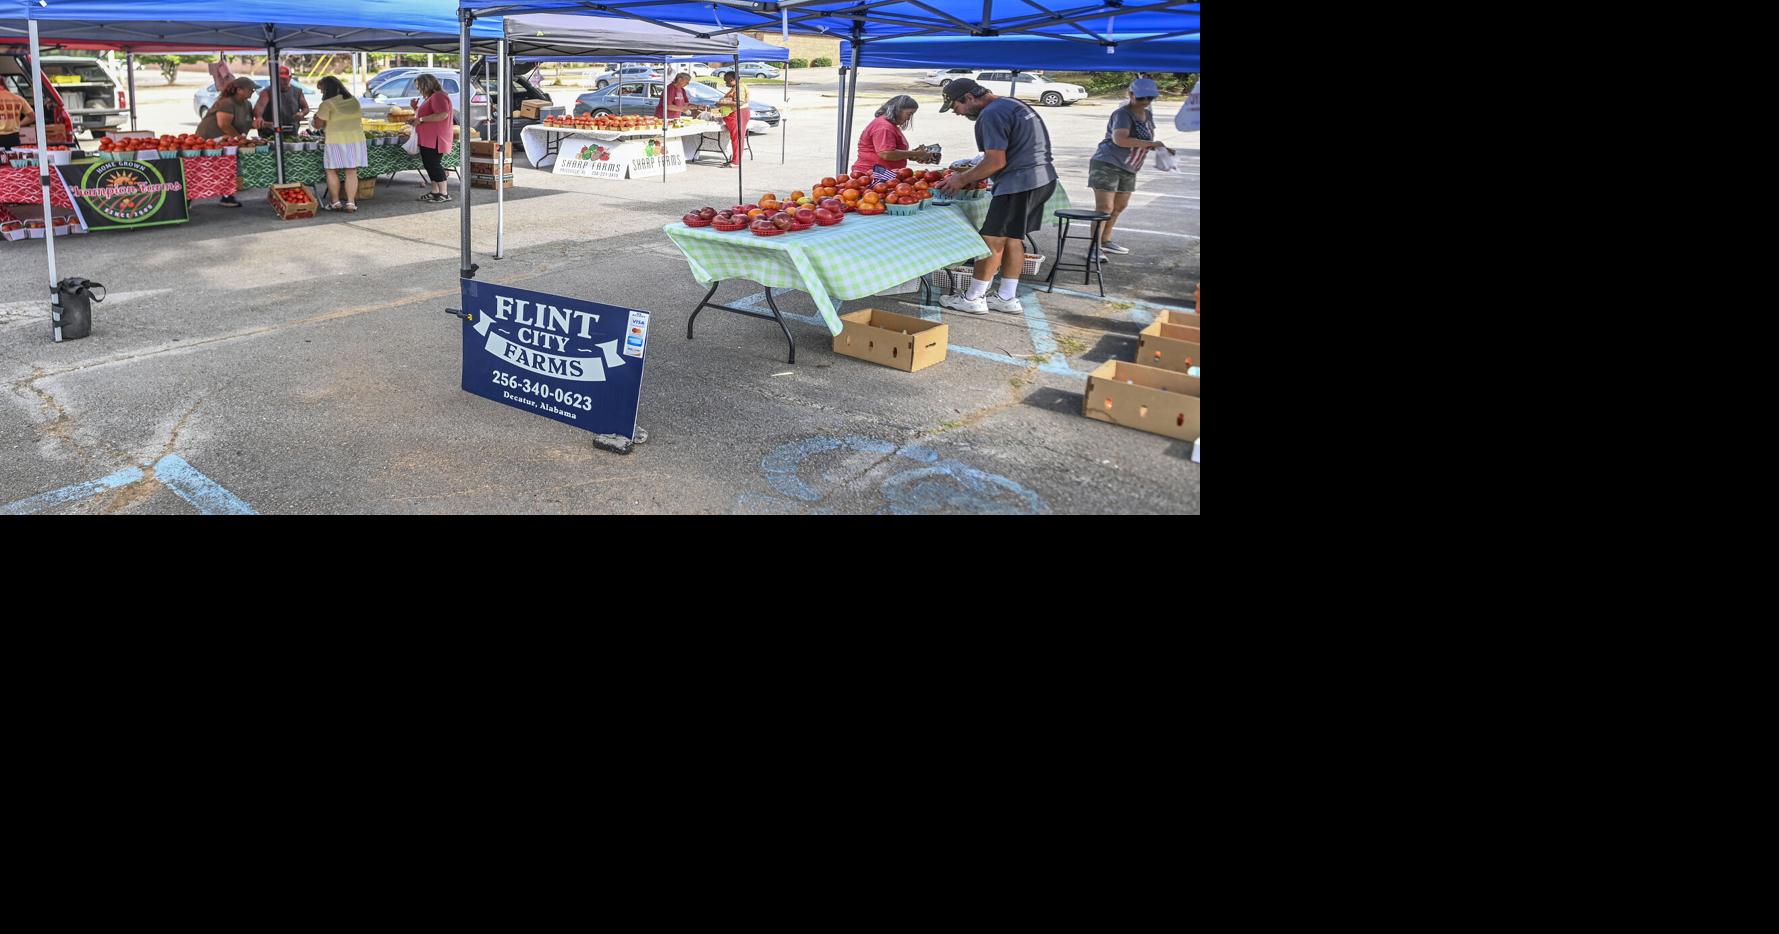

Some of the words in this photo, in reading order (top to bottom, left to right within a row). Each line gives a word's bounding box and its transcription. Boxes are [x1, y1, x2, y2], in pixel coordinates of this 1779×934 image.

[96, 162, 117, 174] HOME
[118, 161, 146, 171] GROWN
[561, 159, 589, 169] SHARP
[592, 161, 621, 172] FARMS
[632, 157, 655, 171] SHARP
[71, 184, 137, 200] hampion
[495, 295, 600, 339] FLINT
[517, 327, 570, 353] CITY
[503, 342, 584, 377] FARMS
[492, 370, 592, 411] 256-340-0623
[503, 390, 538, 408] Decatur,
[540, 402, 577, 420] Alabama
